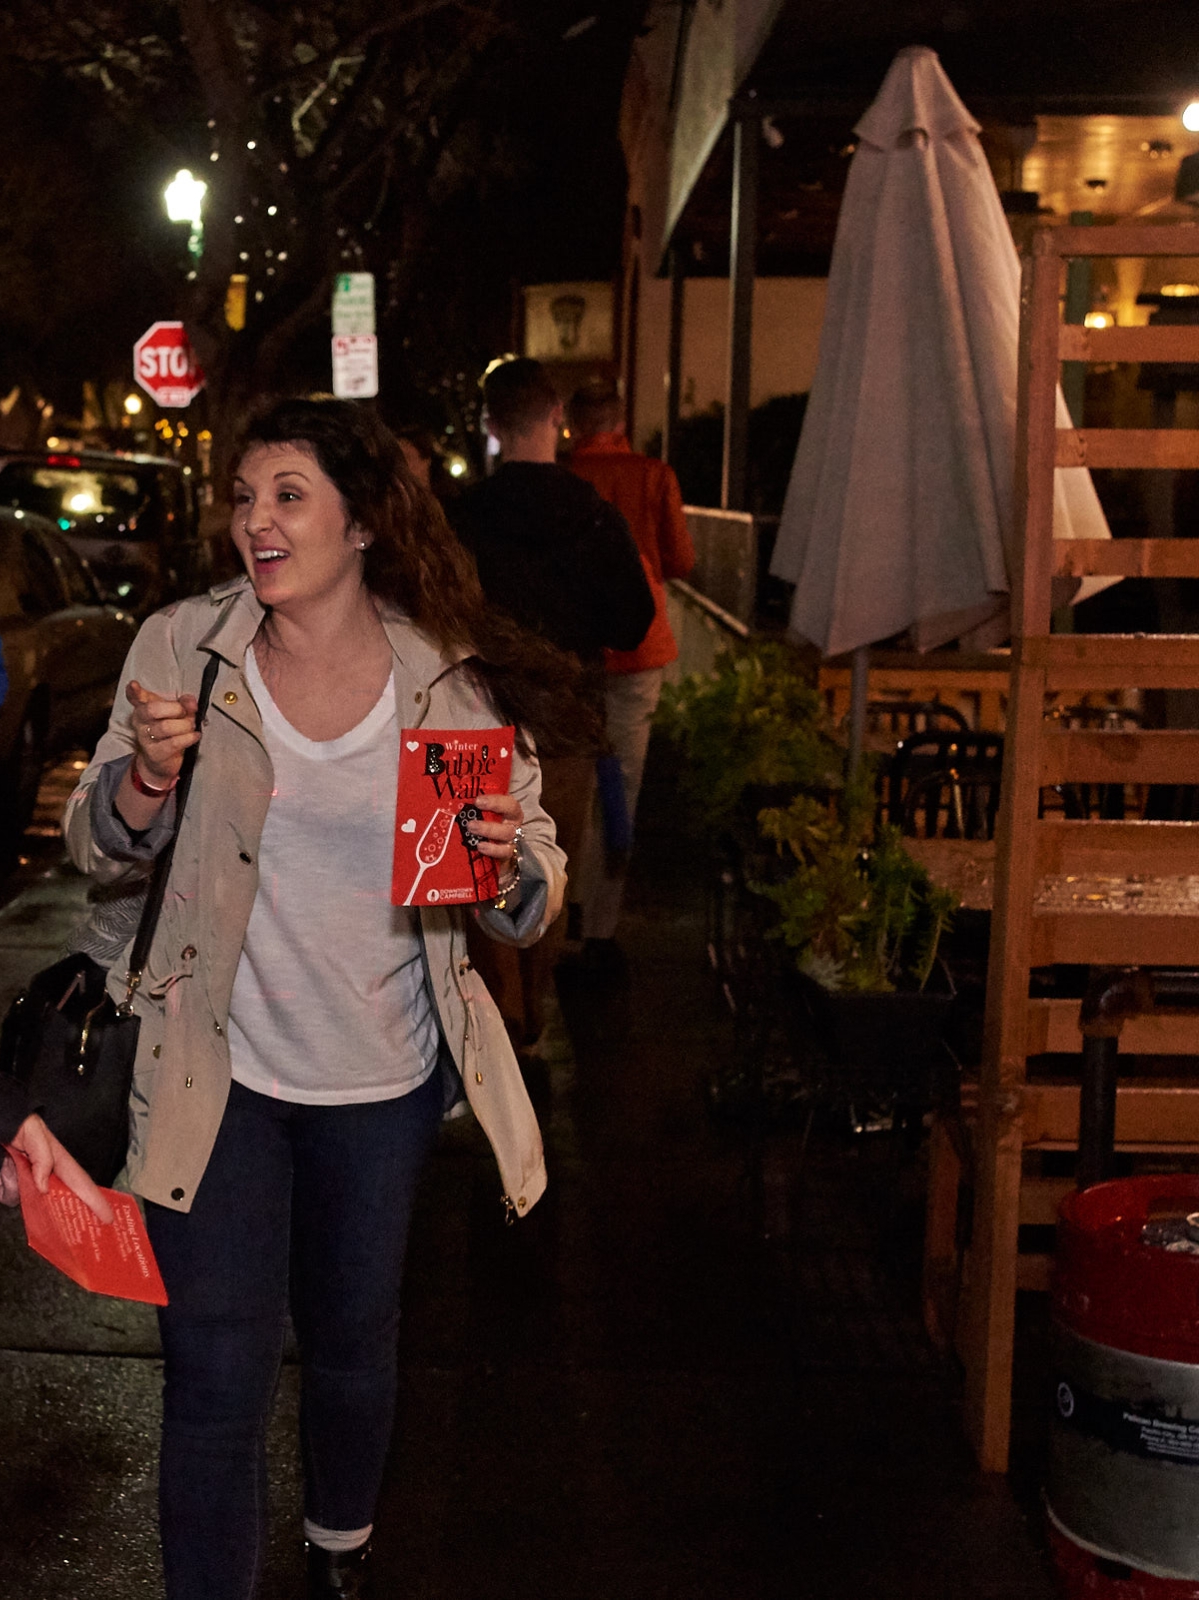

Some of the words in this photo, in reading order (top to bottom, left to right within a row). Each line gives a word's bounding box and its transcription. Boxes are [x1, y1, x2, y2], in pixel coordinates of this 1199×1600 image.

[445, 740, 479, 751] Winter
[422, 743, 496, 776] Bubble
[430, 775, 486, 800] Walk
[440, 891, 473, 900] CAMPBELL
[131, 1236, 150, 1278] Locations
